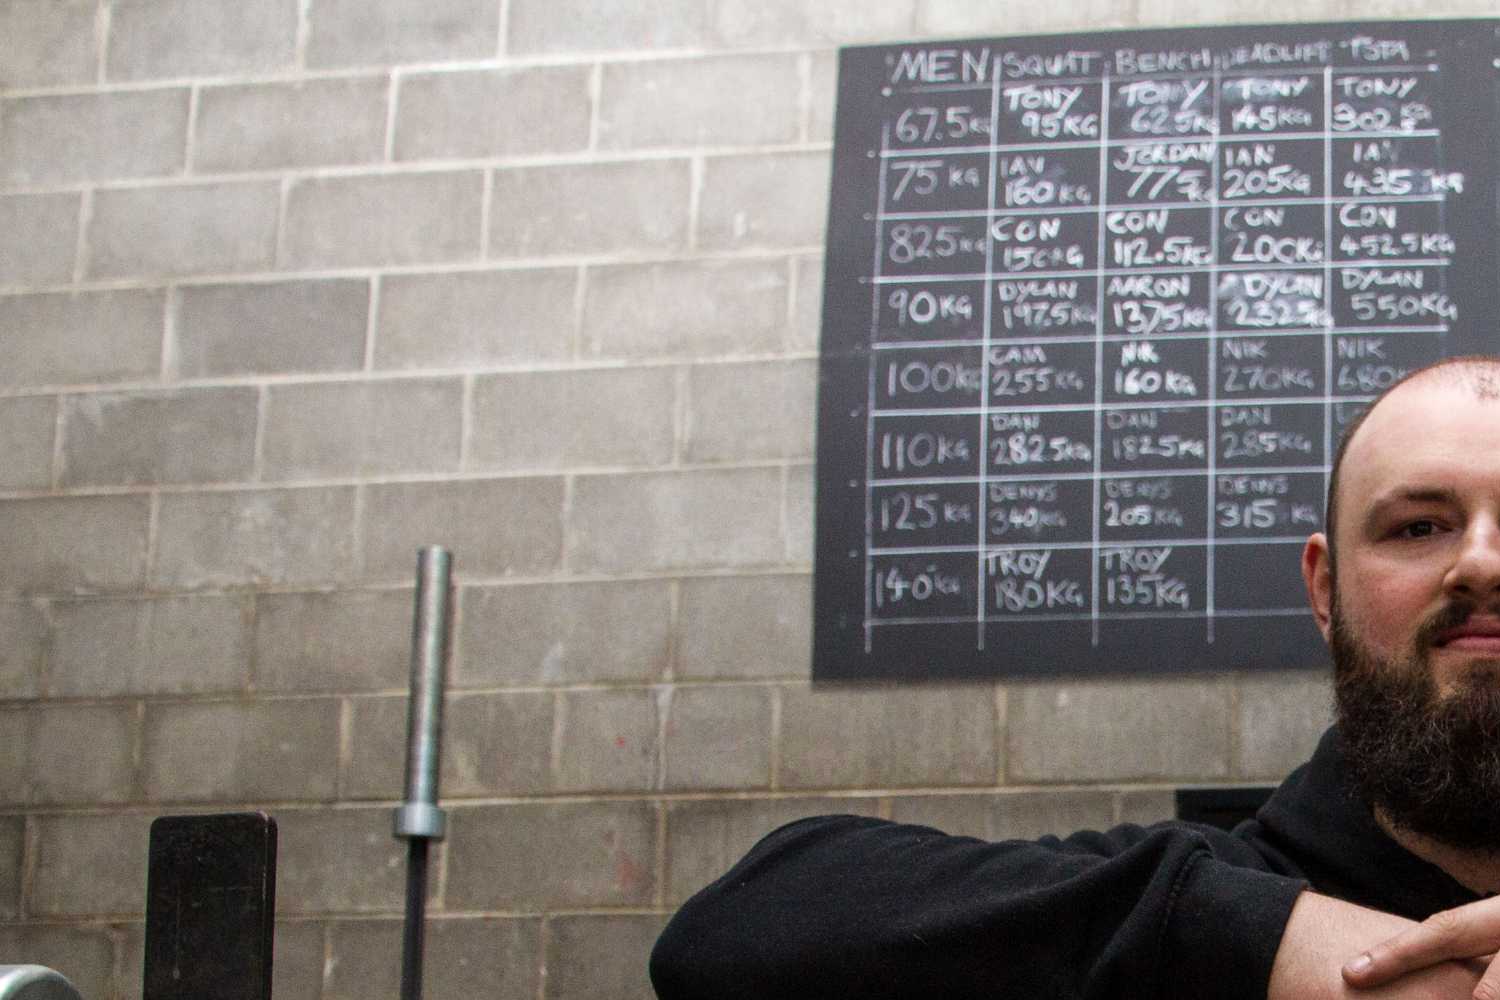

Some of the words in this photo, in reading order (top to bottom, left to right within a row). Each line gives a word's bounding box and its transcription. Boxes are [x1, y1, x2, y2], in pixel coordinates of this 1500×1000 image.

[891, 48, 990, 84] MEN
[1004, 50, 1100, 77] SQUAT
[1115, 48, 1211, 74] BENCH
[1335, 77, 1417, 98] TONY
[1003, 84, 1082, 119] TONY
[1001, 156, 1045, 178] IAN
[1113, 142, 1216, 171] JORDAN
[1225, 144, 1275, 167] IAN
[1107, 209, 1168, 234] CON
[1224, 207, 1285, 231] CON
[1340, 203, 1396, 229] CON
[992, 217, 1060, 242] CON
[999, 280, 1078, 304] DYLAN
[985, 550, 1051, 580] TROY
[1100, 546, 1172, 573] TROY
